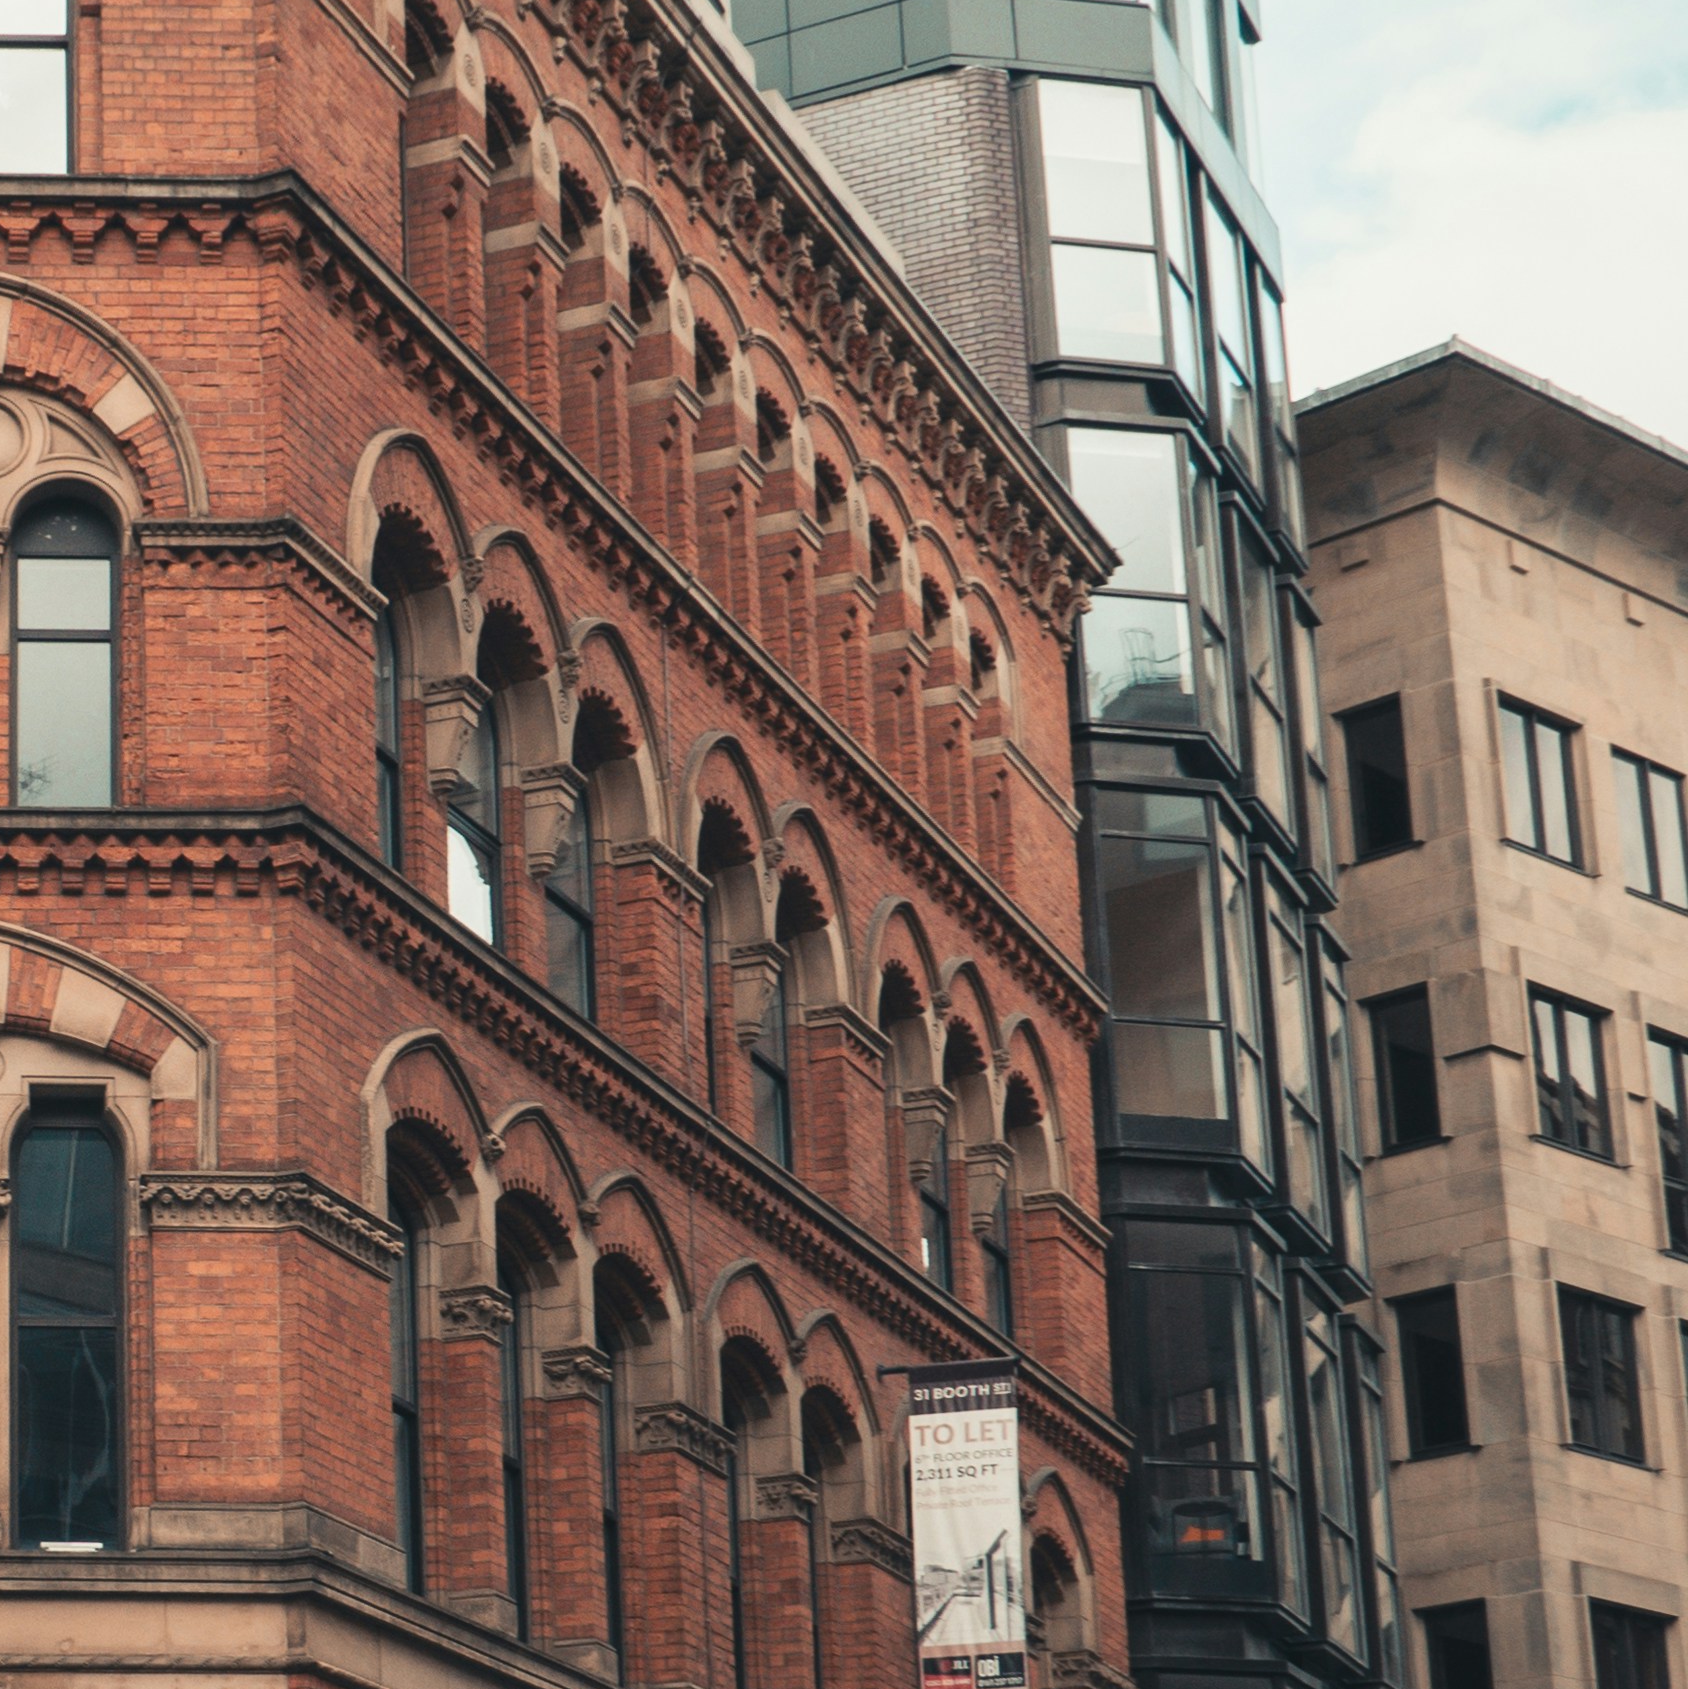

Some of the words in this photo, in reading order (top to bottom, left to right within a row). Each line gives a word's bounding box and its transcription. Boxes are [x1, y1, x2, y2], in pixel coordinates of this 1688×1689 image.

[914, 1389, 929, 1401] 31
[933, 1384, 990, 1399] BOOTH
[914, 1424, 954, 1446] TO
[964, 1419, 1013, 1443] LET
[933, 1452, 970, 1463] FLOOR
[973, 1448, 1013, 1460] OFFICE
[916, 1467, 952, 1482] 2,311
[957, 1465, 977, 1479] SQ
[981, 1463, 998, 1476] FT
